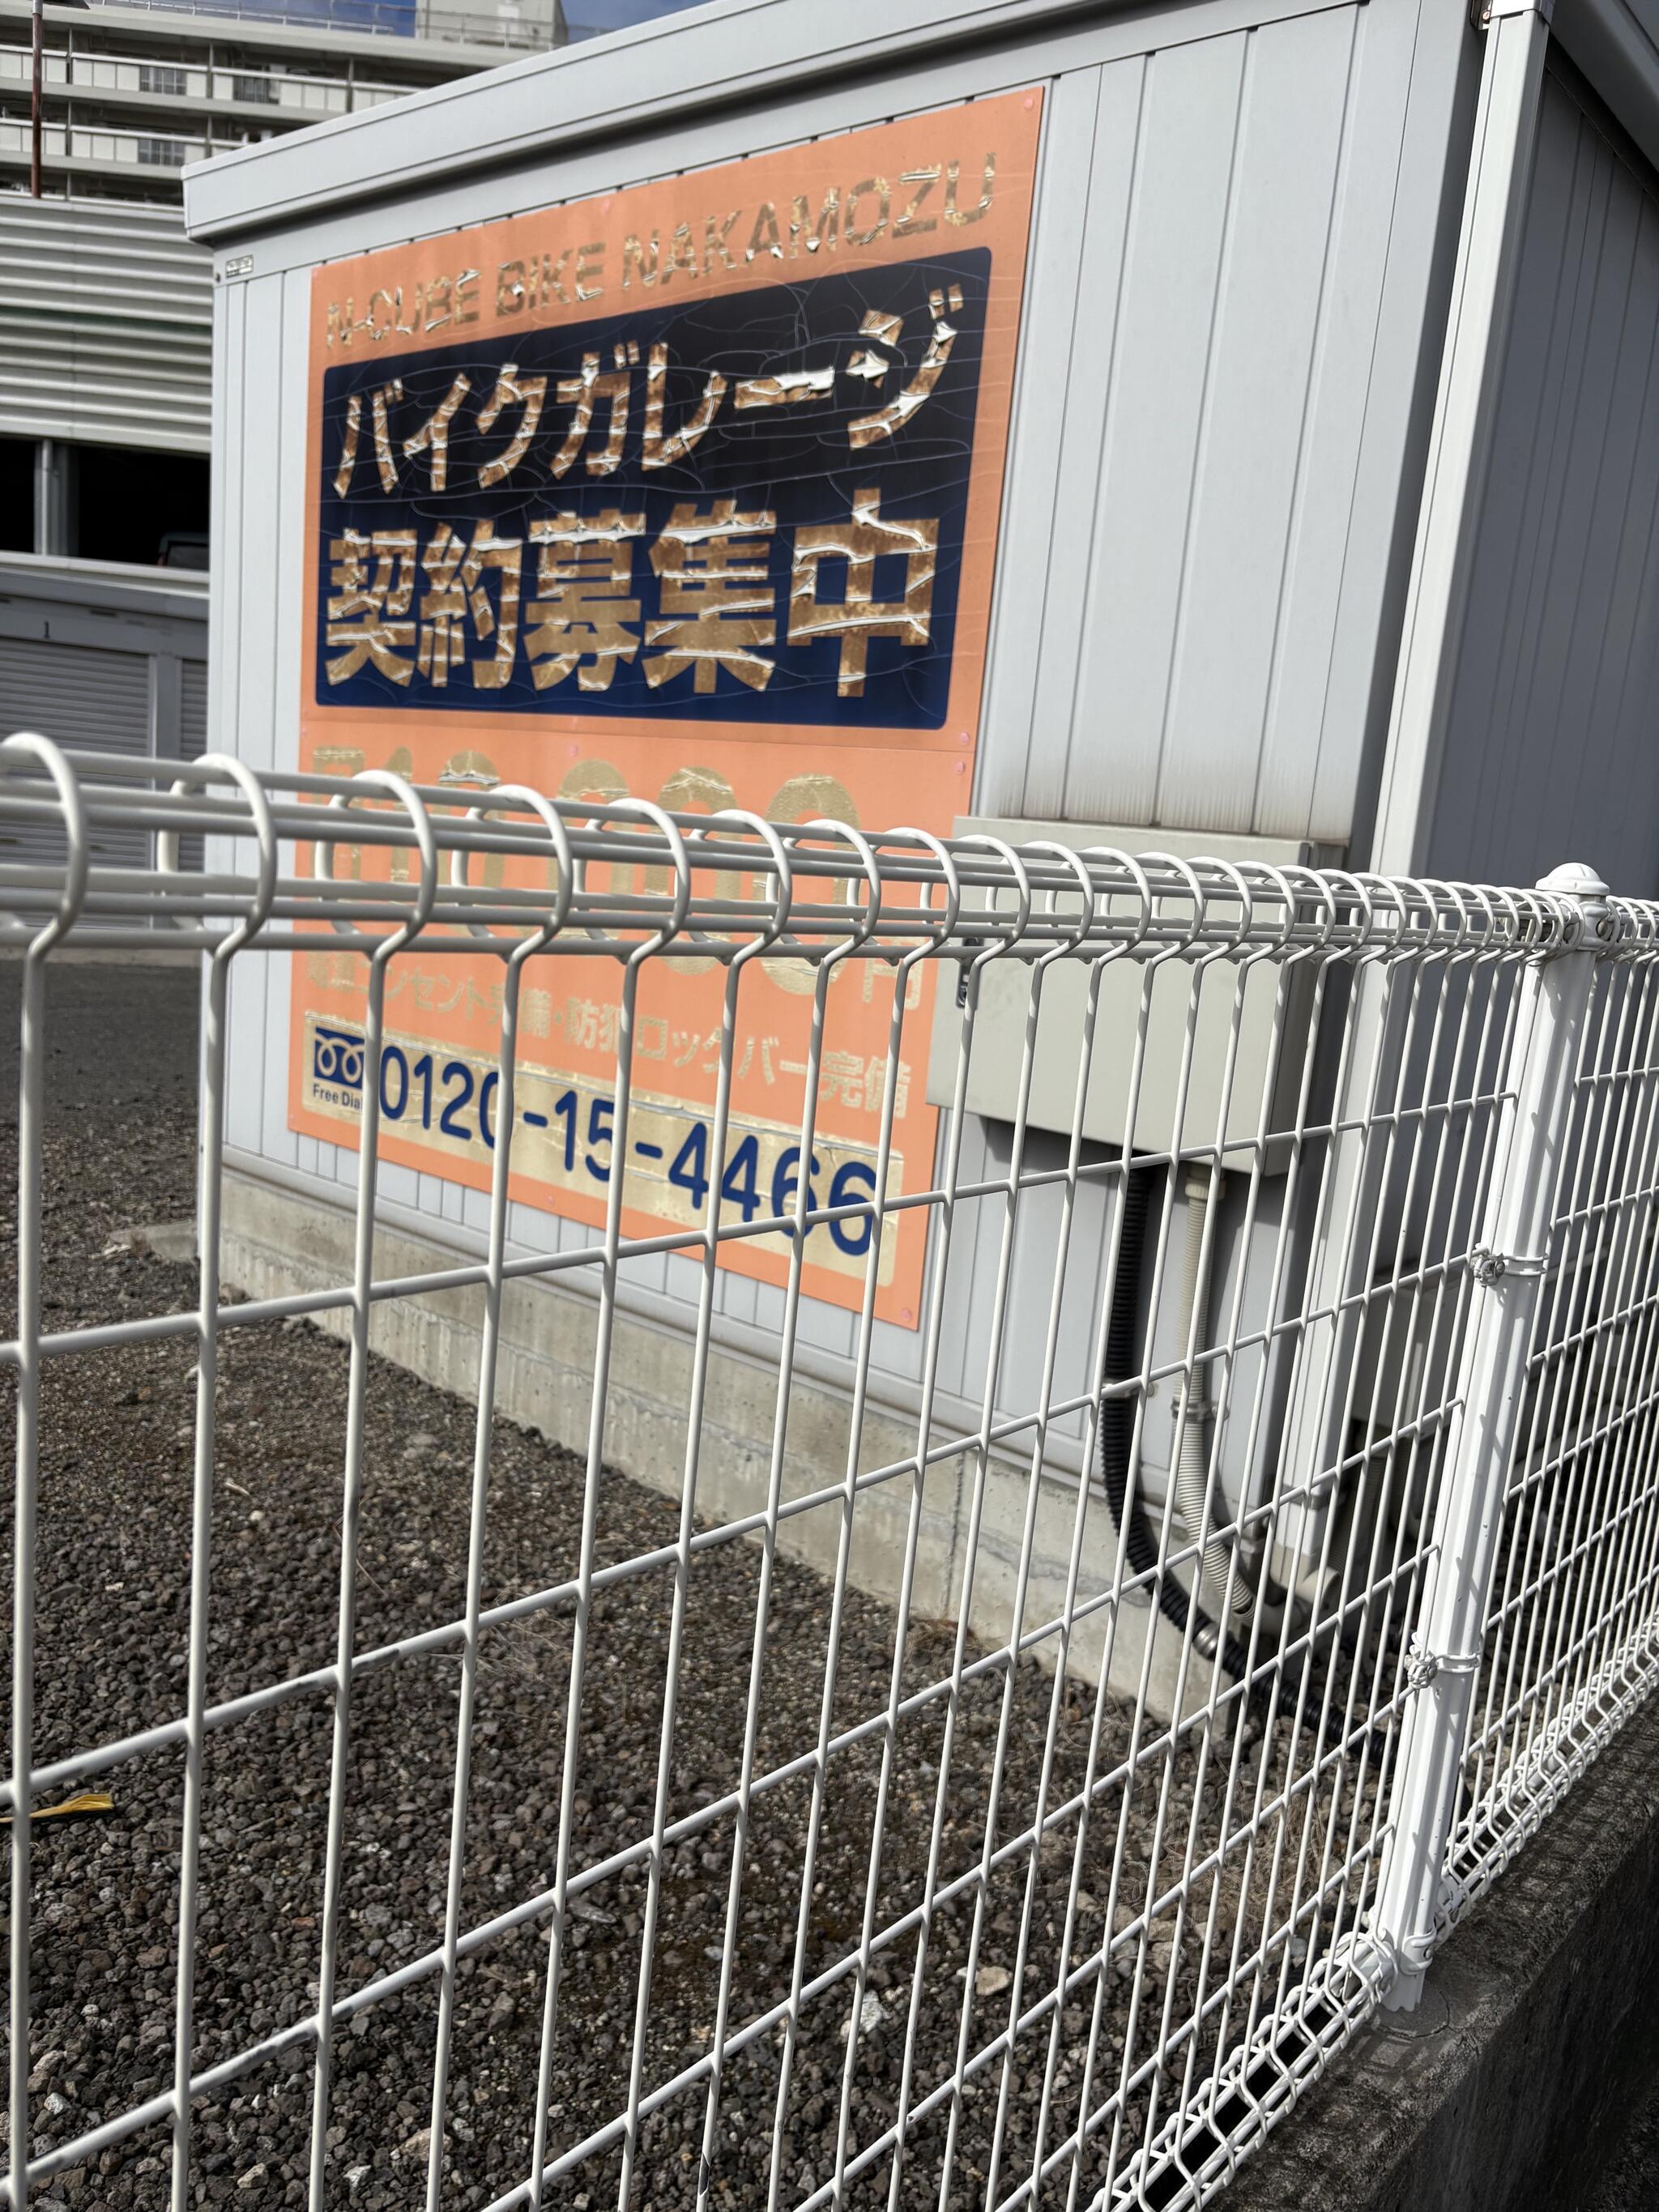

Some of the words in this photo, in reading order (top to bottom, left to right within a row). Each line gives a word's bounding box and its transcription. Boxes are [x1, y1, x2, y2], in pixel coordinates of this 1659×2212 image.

[497, 242, 605, 318] BIKE
[623, 151, 996, 290] NAKAMOZU
[333, 283, 963, 497] バイクガレージ
[325, 488, 940, 697] 契約募集中
[313, 1082, 339, 1104] Free
